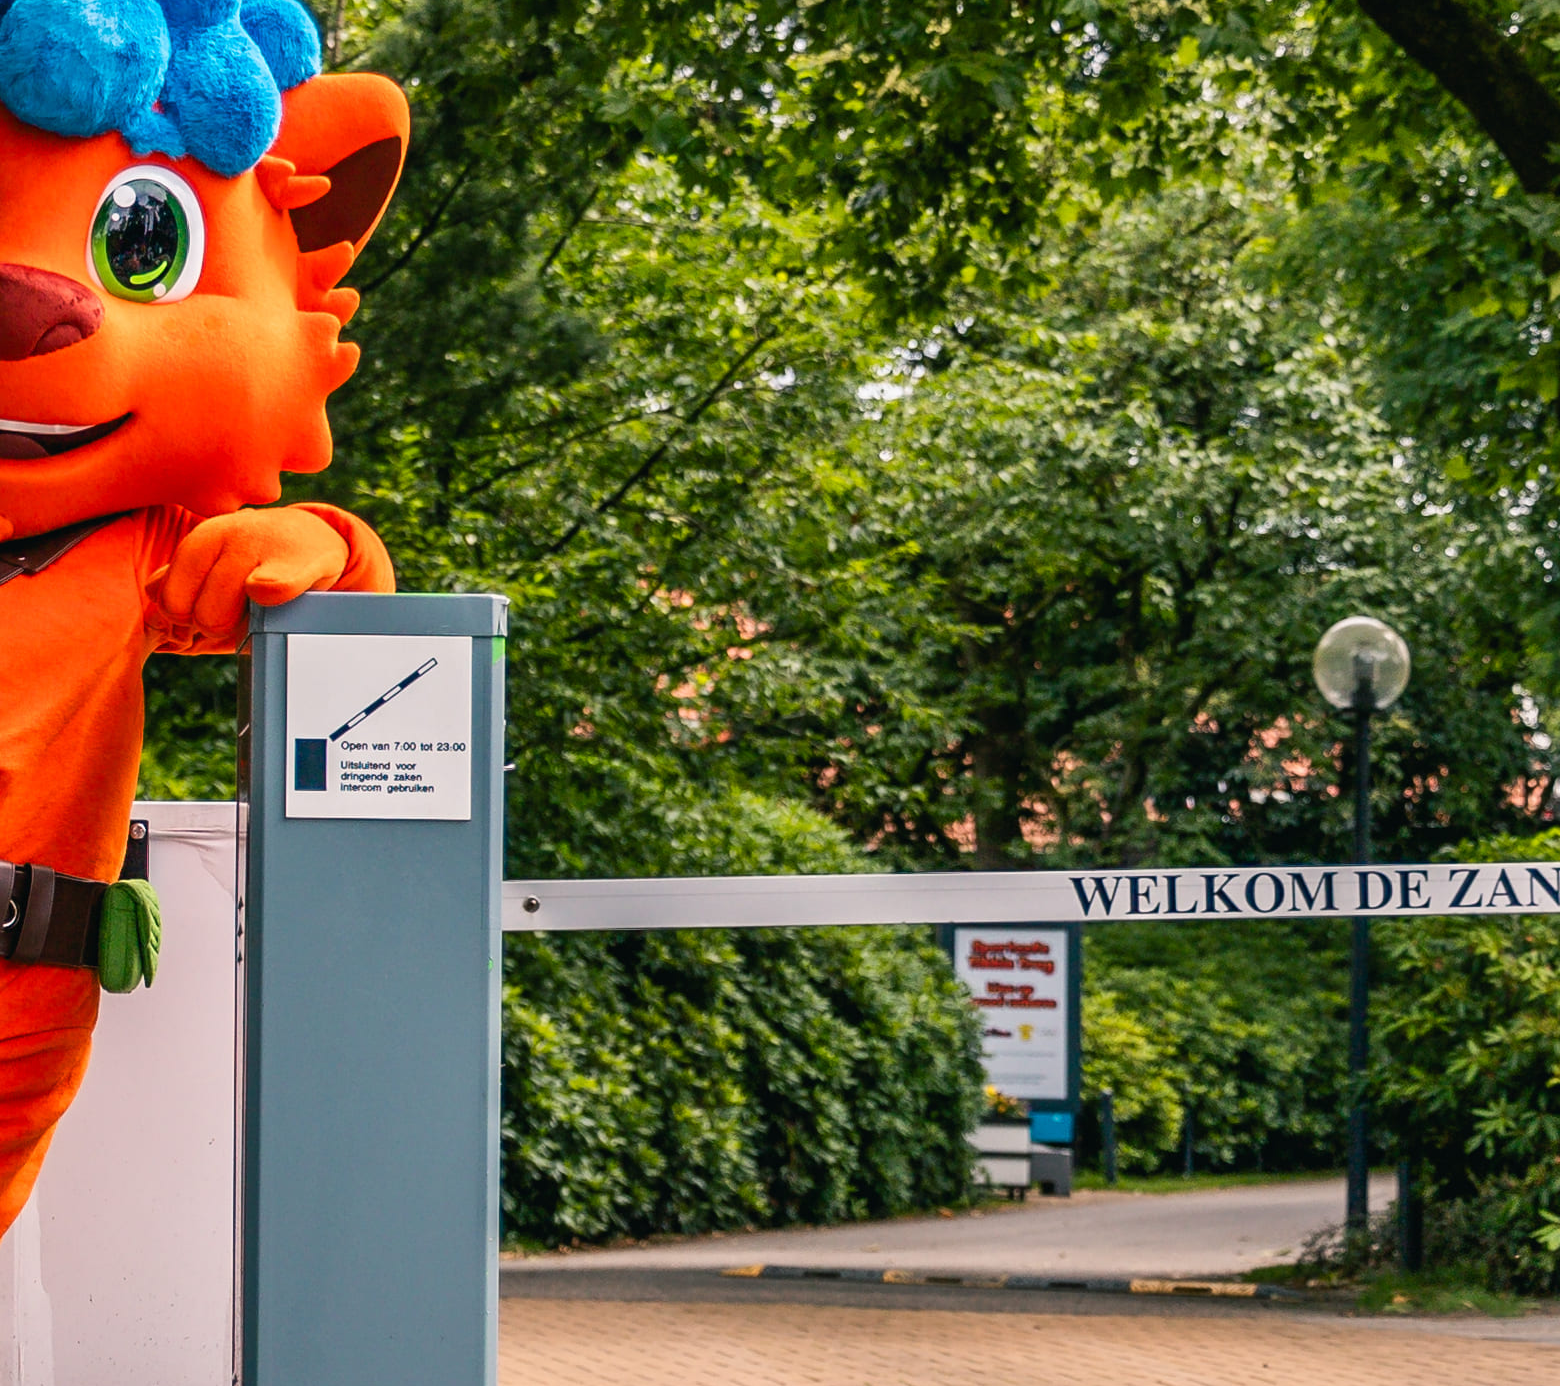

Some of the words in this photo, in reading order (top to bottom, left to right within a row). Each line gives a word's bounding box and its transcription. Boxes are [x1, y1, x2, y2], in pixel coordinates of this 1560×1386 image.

[340, 741, 368, 751] Open
[372, 743, 390, 751] van
[420, 742, 433, 751] tot
[436, 742, 466, 752] 23:00
[340, 761, 390, 770] Uitsluitend
[340, 772, 389, 782] dringende
[394, 773, 422, 781] zaken
[387, 784, 434, 793] gebruiken
[1069, 871, 1340, 916] WELKOM
[1355, 869, 1432, 910] DE
